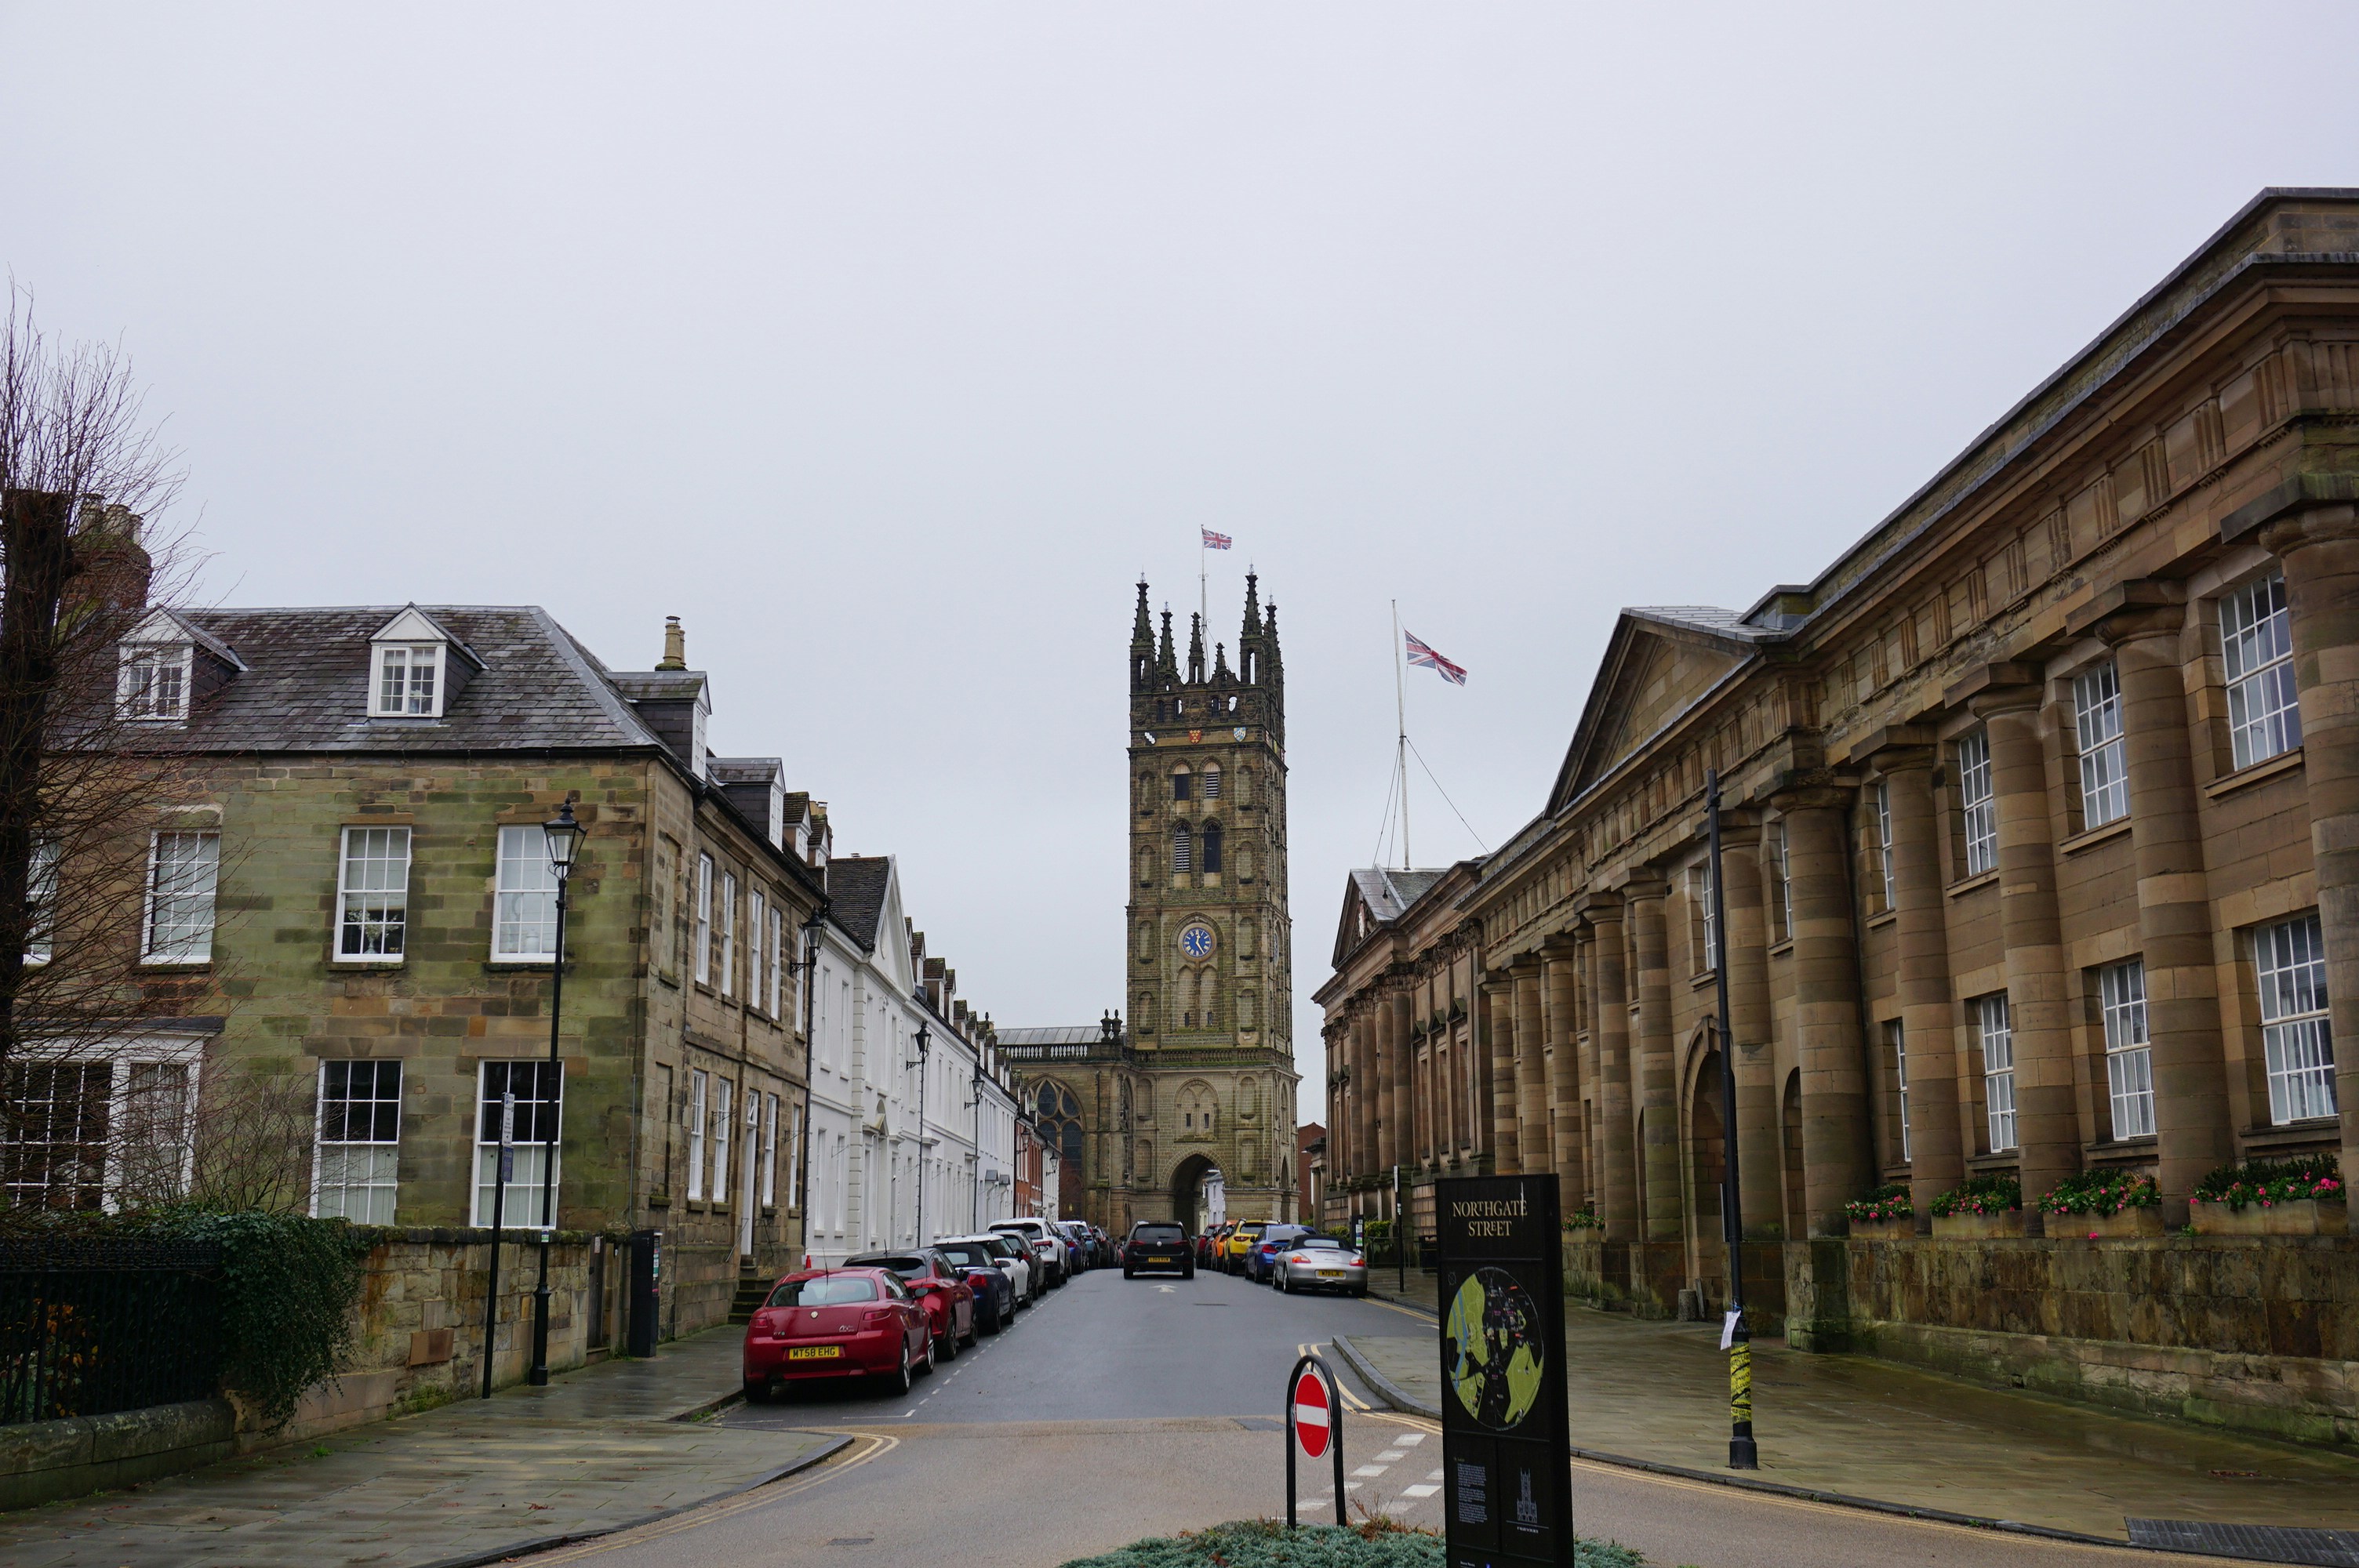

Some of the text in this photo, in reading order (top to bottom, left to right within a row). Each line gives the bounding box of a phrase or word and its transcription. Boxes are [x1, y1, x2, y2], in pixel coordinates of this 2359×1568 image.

[1452, 1200, 1528, 1218] NORTHGATE
[1468, 1220, 1512, 1237] STREET
[793, 1347, 836, 1358] MT58 EHG
